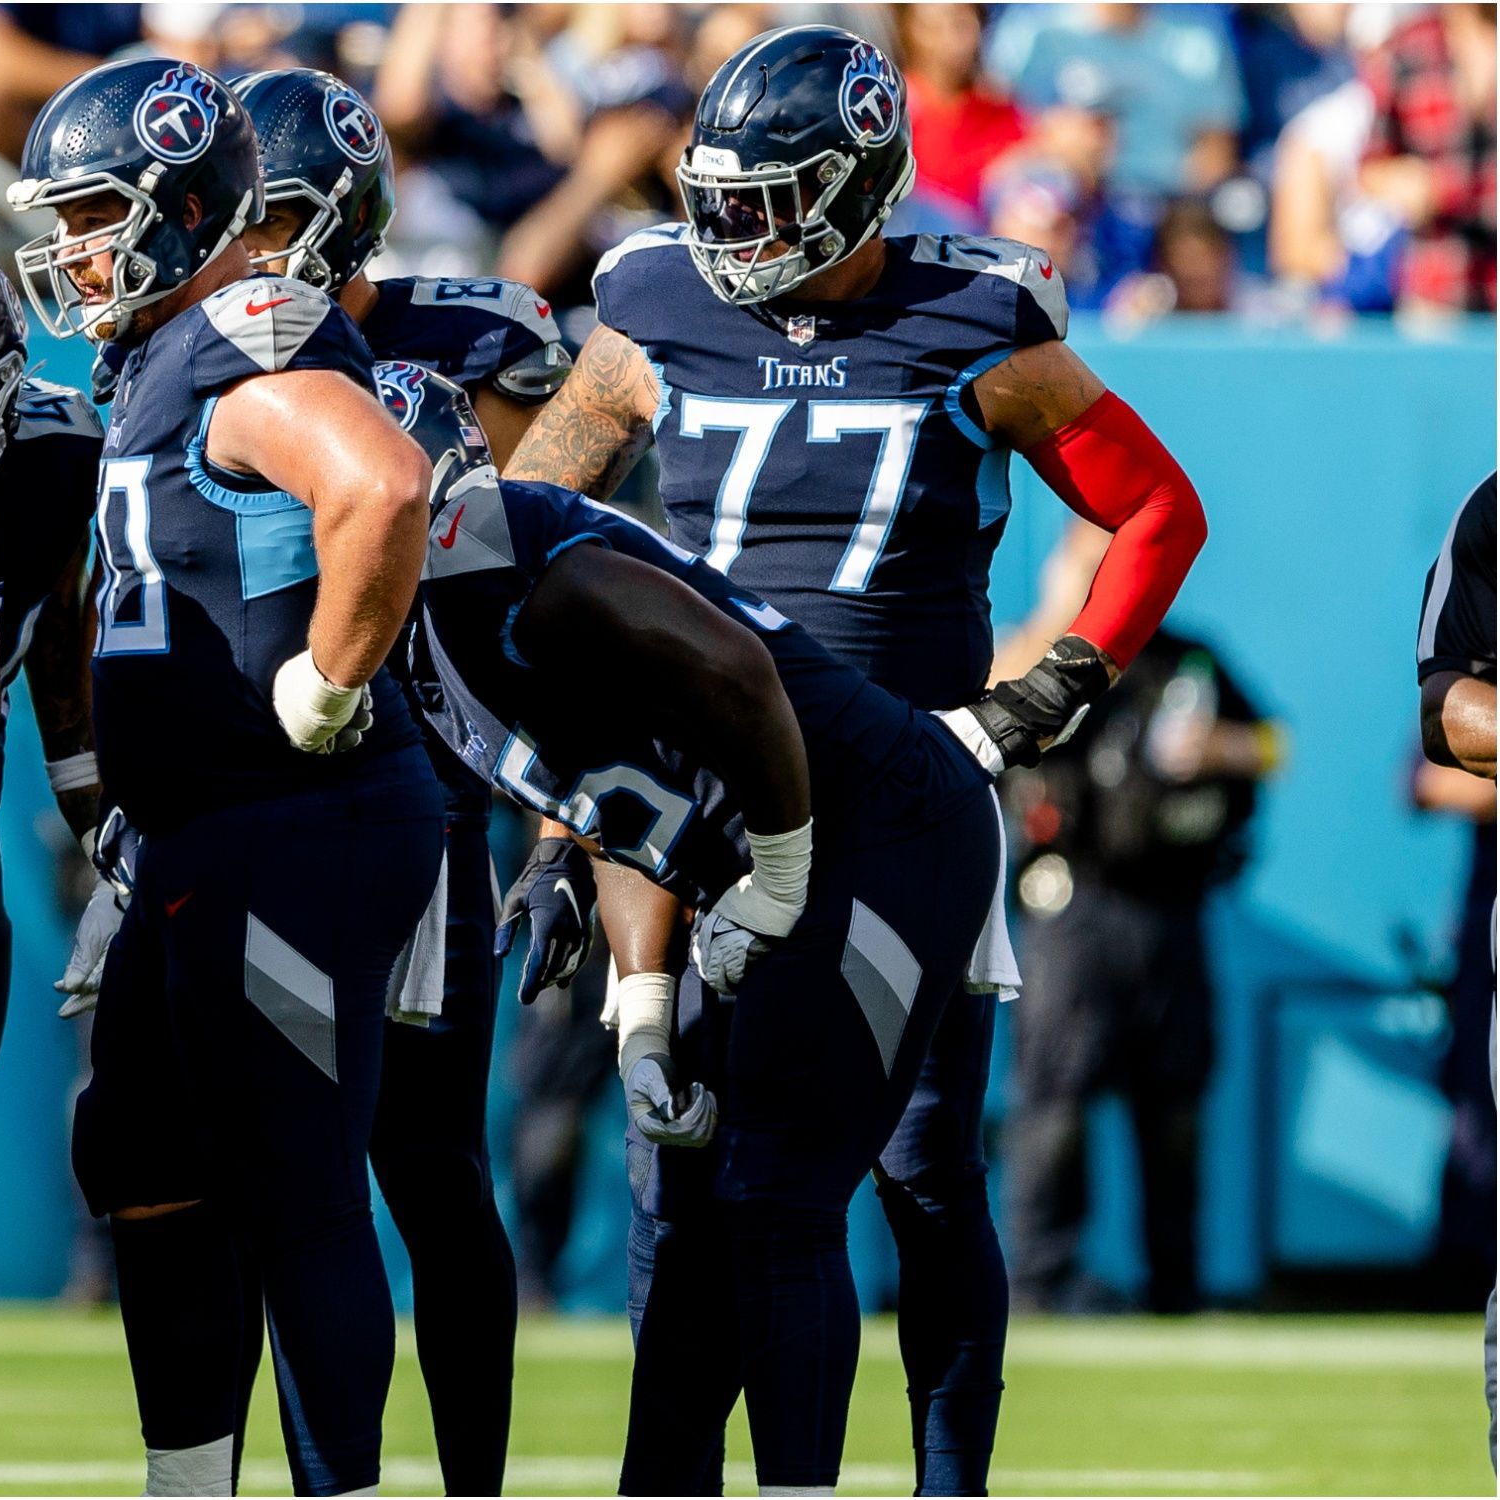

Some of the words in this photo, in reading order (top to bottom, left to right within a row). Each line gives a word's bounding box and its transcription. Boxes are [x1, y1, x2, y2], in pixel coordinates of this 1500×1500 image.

[757, 355, 849, 391] TITANS
[92, 454, 171, 658] 0
[678, 395, 930, 592] 77
